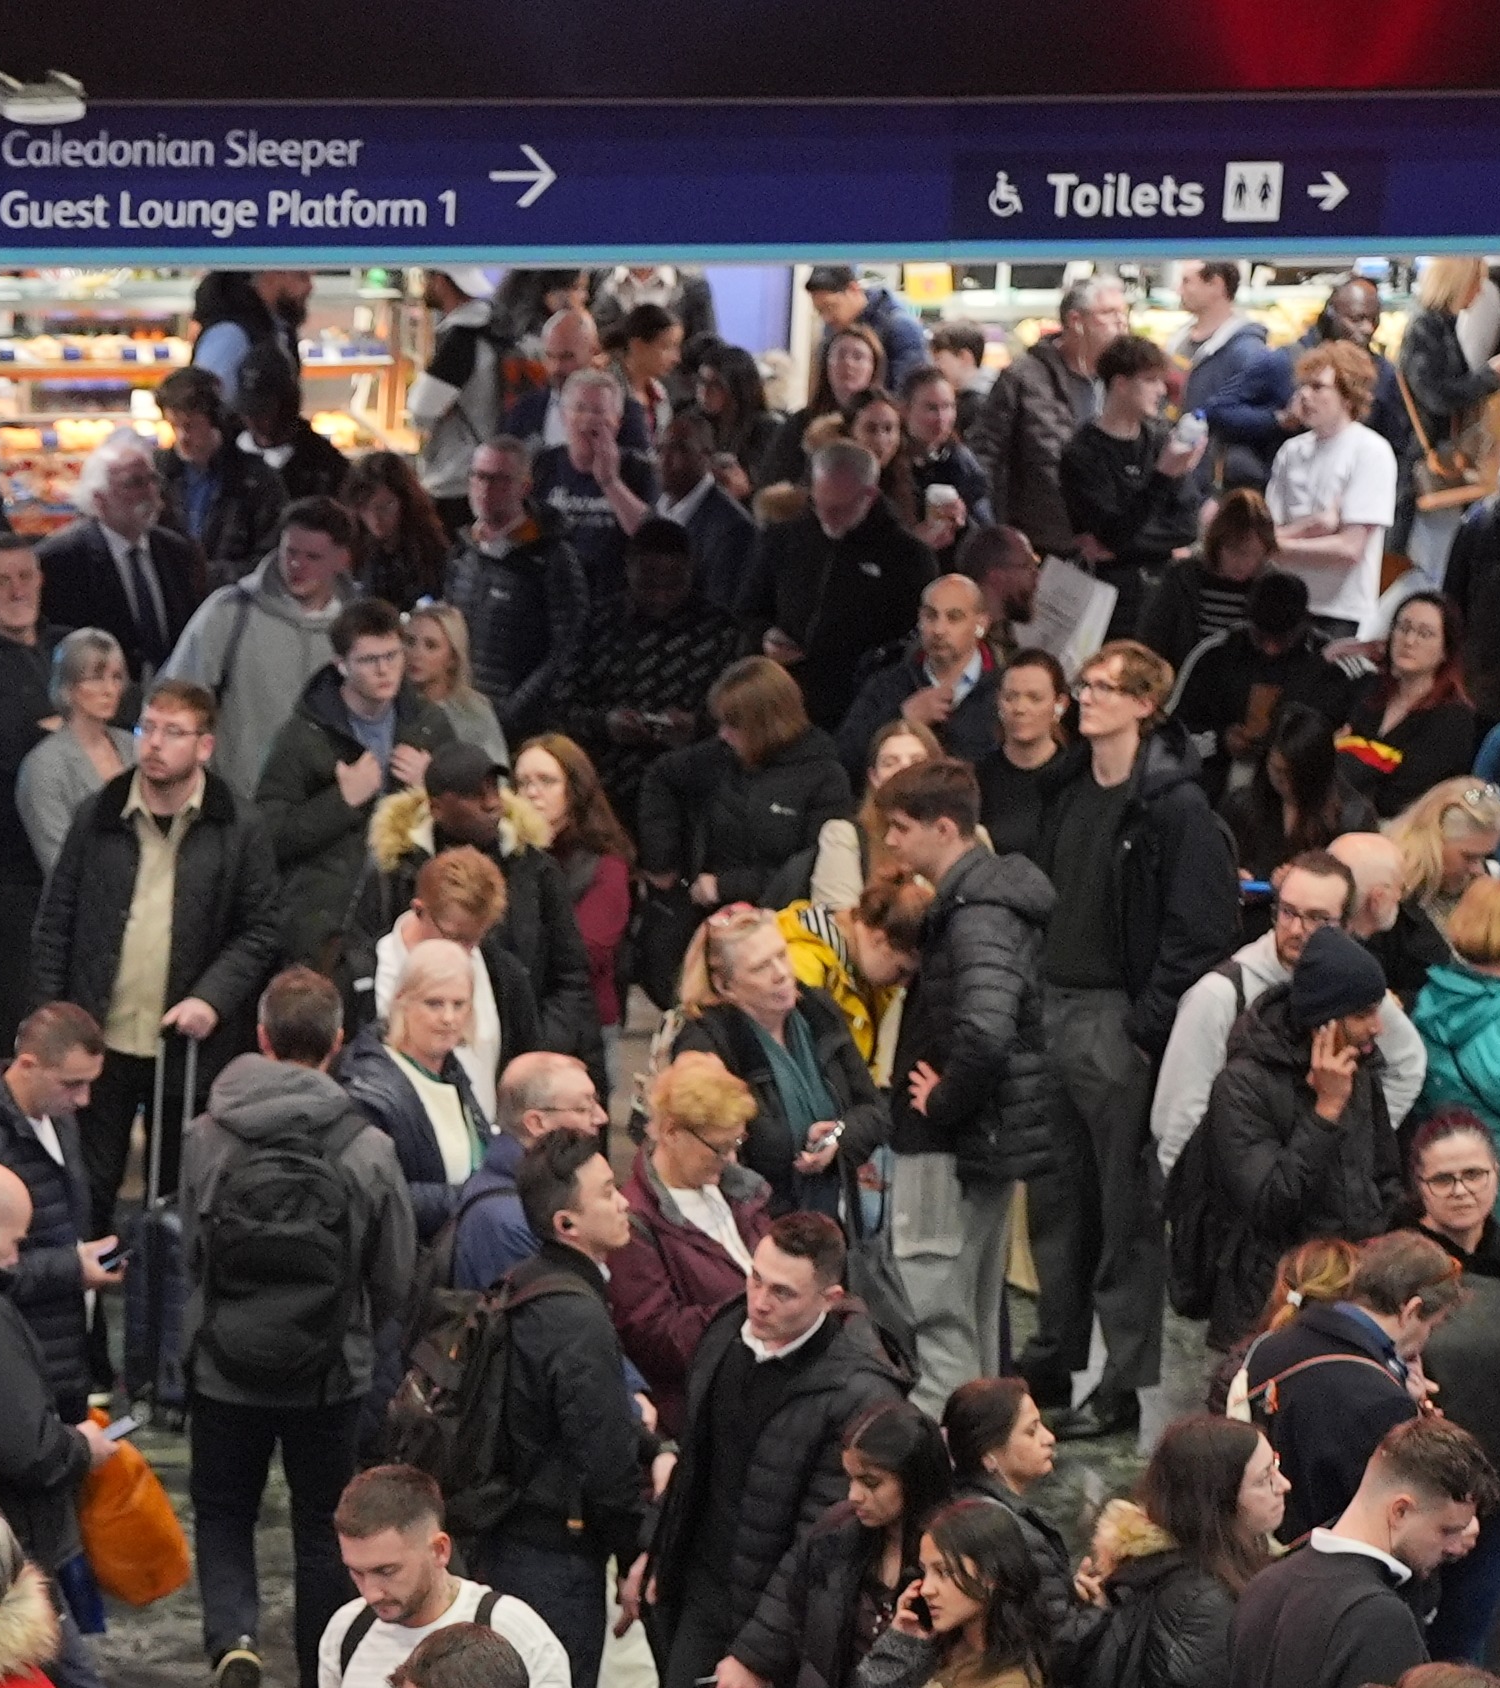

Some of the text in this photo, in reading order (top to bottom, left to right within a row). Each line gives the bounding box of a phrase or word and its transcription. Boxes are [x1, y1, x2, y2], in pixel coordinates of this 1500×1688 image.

[0, 129, 364, 176] Caledonian Sleeper
[117, 189, 260, 238] Lounge
[266, 188, 428, 229] Platform
[436, 189, 458, 228] 1
[1045, 171, 1206, 219] Toilets
